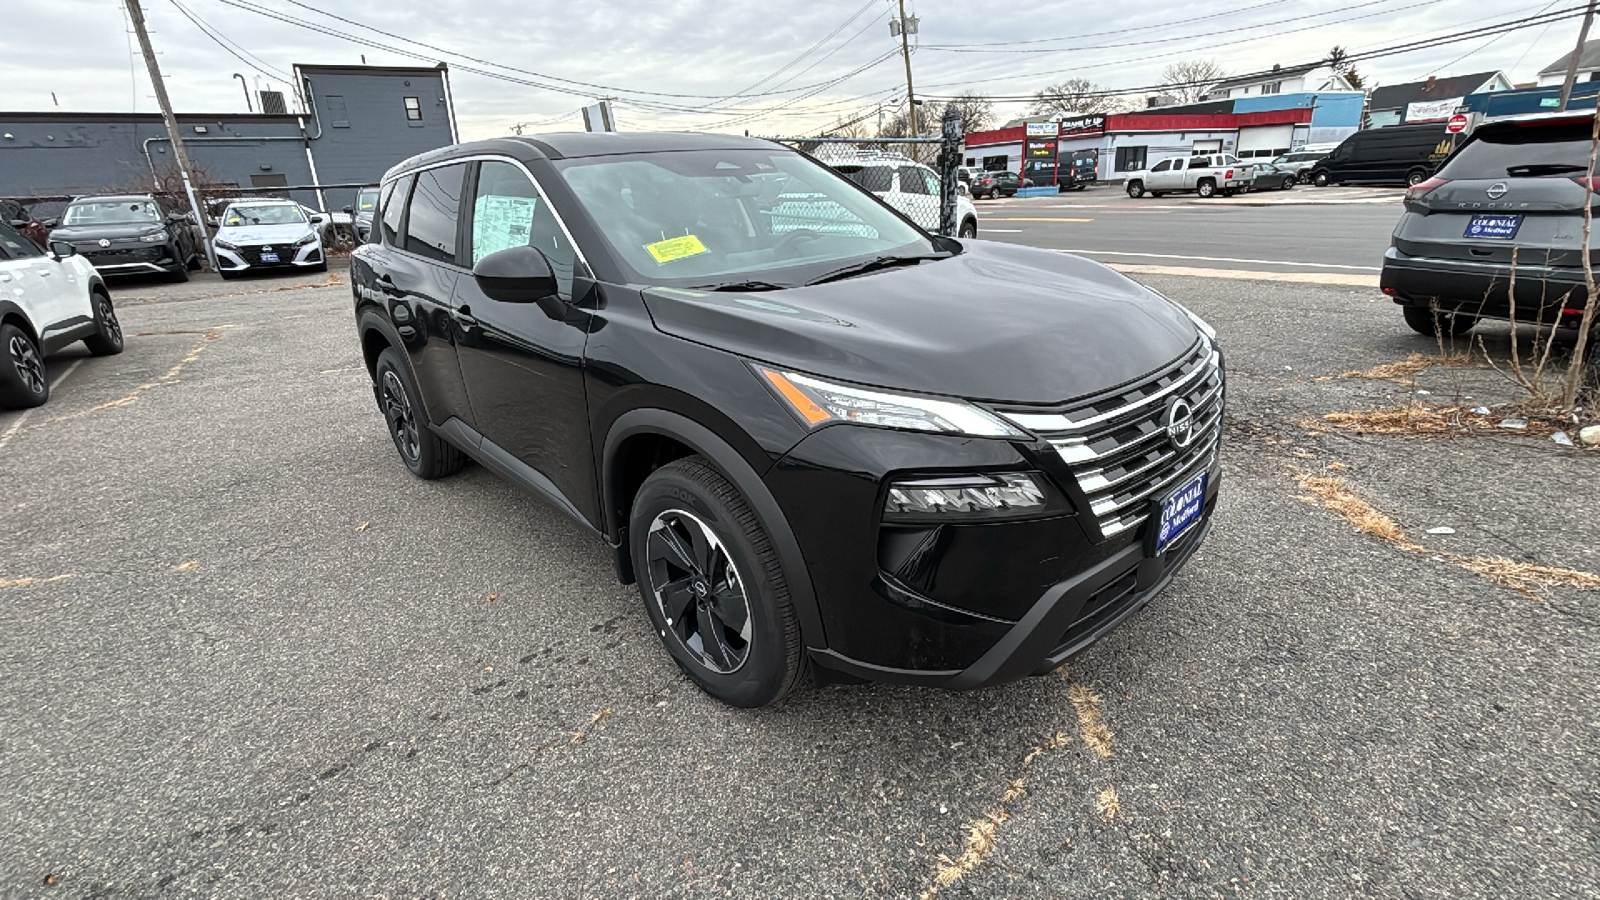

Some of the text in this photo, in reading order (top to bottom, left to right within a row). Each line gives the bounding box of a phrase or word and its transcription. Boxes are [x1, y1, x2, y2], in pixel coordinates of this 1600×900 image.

[1472, 219, 1517, 228] COLONIAL
[1483, 226, 1513, 234] Medford
[1161, 486, 1203, 525] COLONIAL
[1171, 500, 1199, 528] Medford
